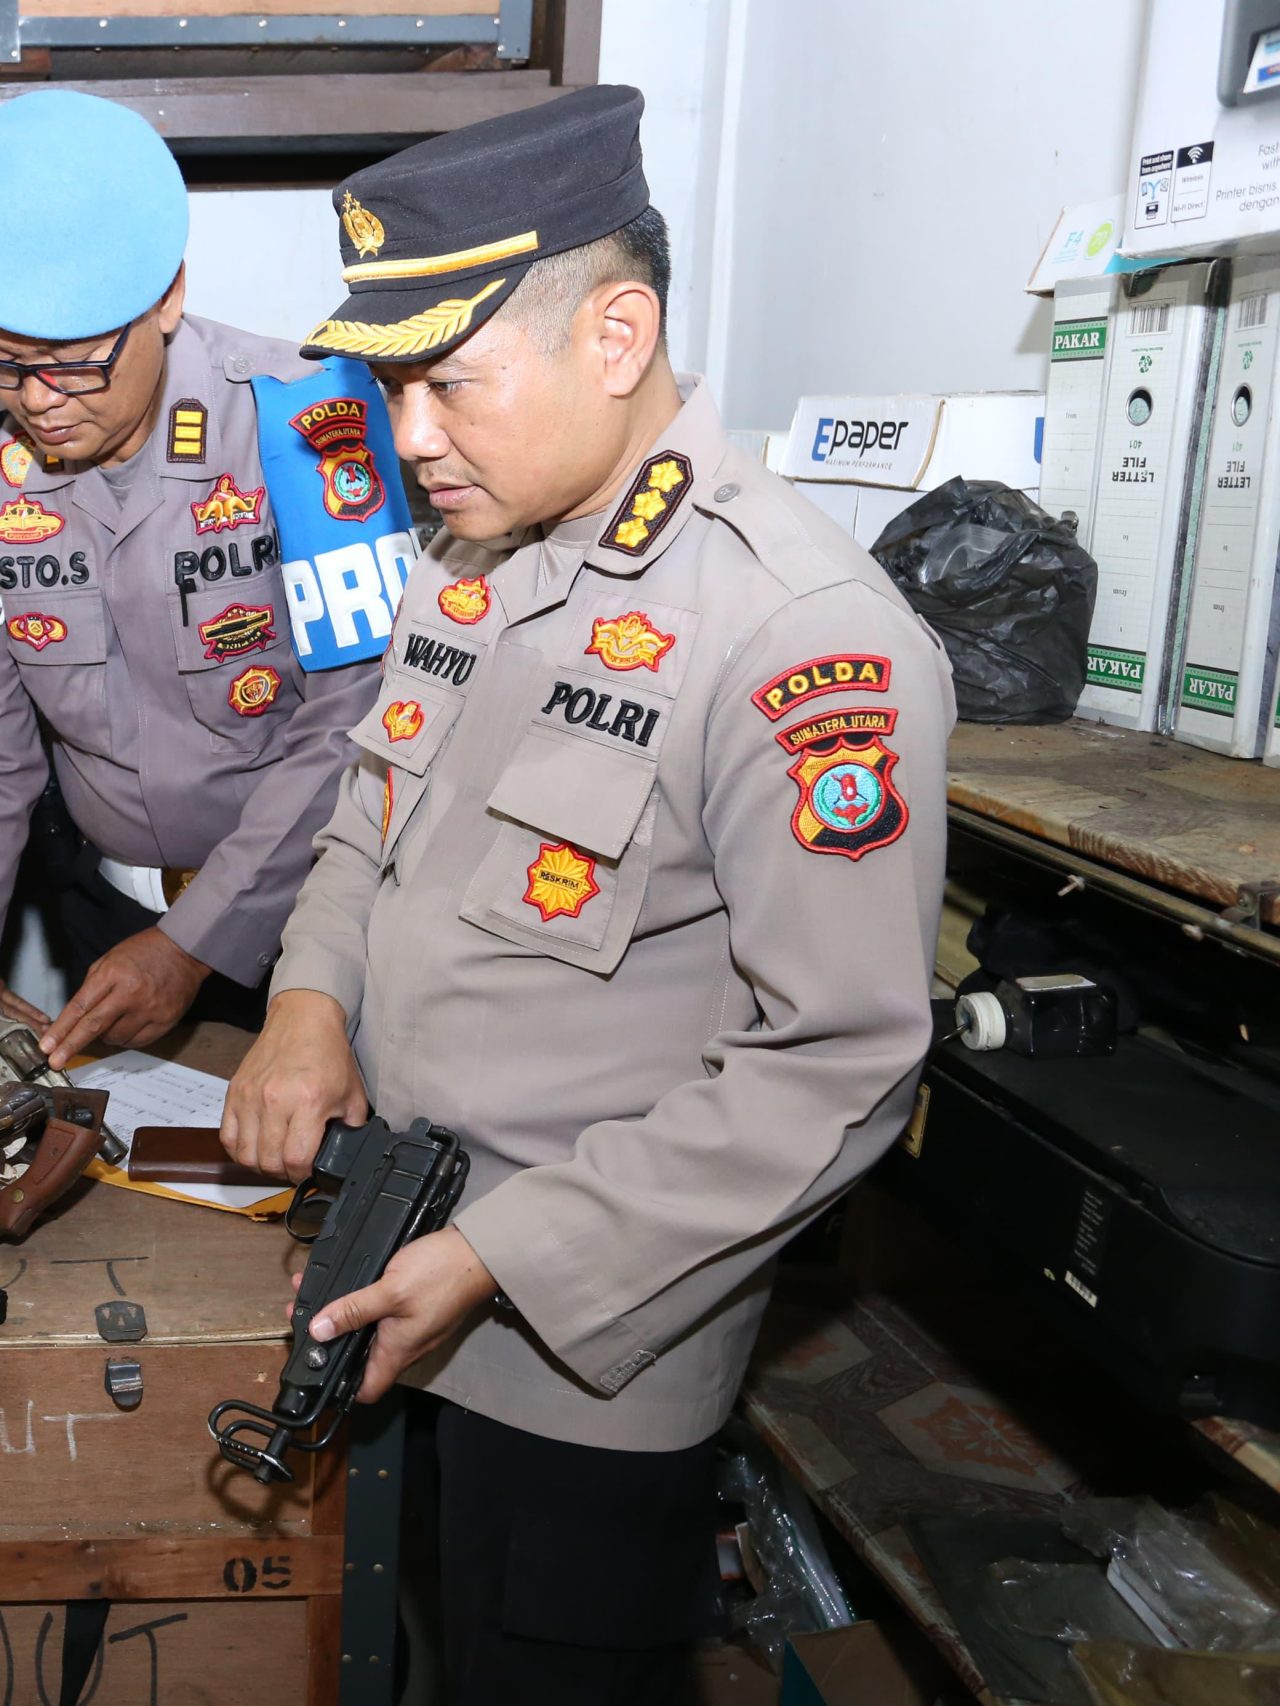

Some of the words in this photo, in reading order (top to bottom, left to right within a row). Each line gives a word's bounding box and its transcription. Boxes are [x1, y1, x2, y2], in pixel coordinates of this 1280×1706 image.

[1055, 332, 1100, 350] PAKAR
[301, 402, 360, 430] POLDA
[811, 418, 909, 462] Epaper
[1122, 457, 1147, 468] FILE
[1226, 461, 1246, 473] FILE
[1112, 471, 1155, 483] LETTER
[1217, 476, 1251, 489] LETTER
[174, 528, 281, 585] POLRI
[403, 632, 477, 687] WAHYU
[1087, 656, 1142, 680] PAKAR
[766, 661, 879, 710] POLDA
[1190, 677, 1235, 701] PAKAR
[541, 681, 660, 747] POLRI
[790, 717, 851, 745] SUMATERA
[851, 714, 886, 730] UTARA
[540, 871, 580, 890] RESKRIM
[223, 1555, 292, 1593] 05
